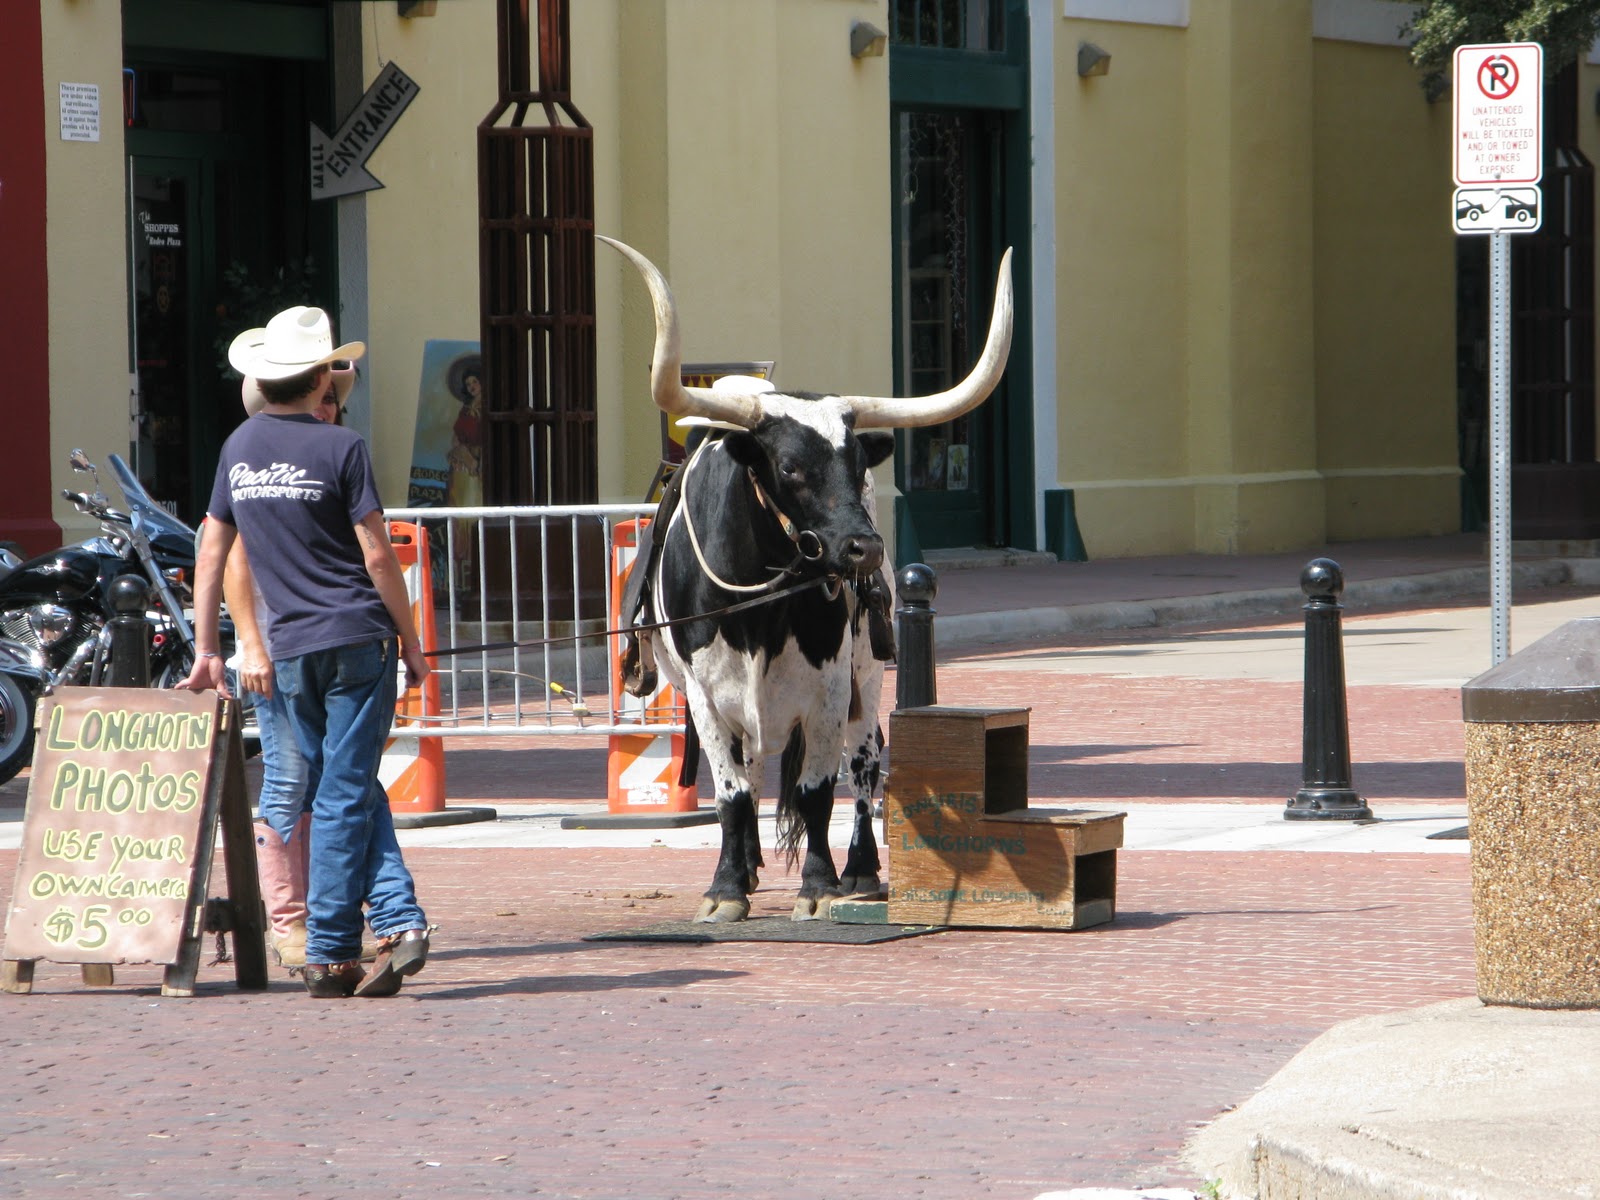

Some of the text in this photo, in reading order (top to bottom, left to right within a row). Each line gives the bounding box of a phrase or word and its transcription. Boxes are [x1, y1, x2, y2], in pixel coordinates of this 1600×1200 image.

[1472, 105, 1523, 116] UNATTENDED
[325, 71, 411, 178] ENTRANCE
[1480, 117, 1517, 127] VEHICLES
[1462, 128, 1534, 140] WILL BE TICKETED
[1502, 141, 1528, 150] TOWED
[1475, 152, 1521, 163] AT OWNERS
[312, 144, 325, 189] MALL
[1480, 165, 1515, 175] EXPENSE
[144, 223, 179, 233] SHOPPES
[229, 462, 324, 488] Pacific
[231, 485, 322, 503] MOTORSPORTS
[410, 486, 444, 502] PLAZA
[43, 828, 104, 862] USE
[902, 832, 1026, 856] LONGHORNS
[29, 872, 105, 900] OWN
